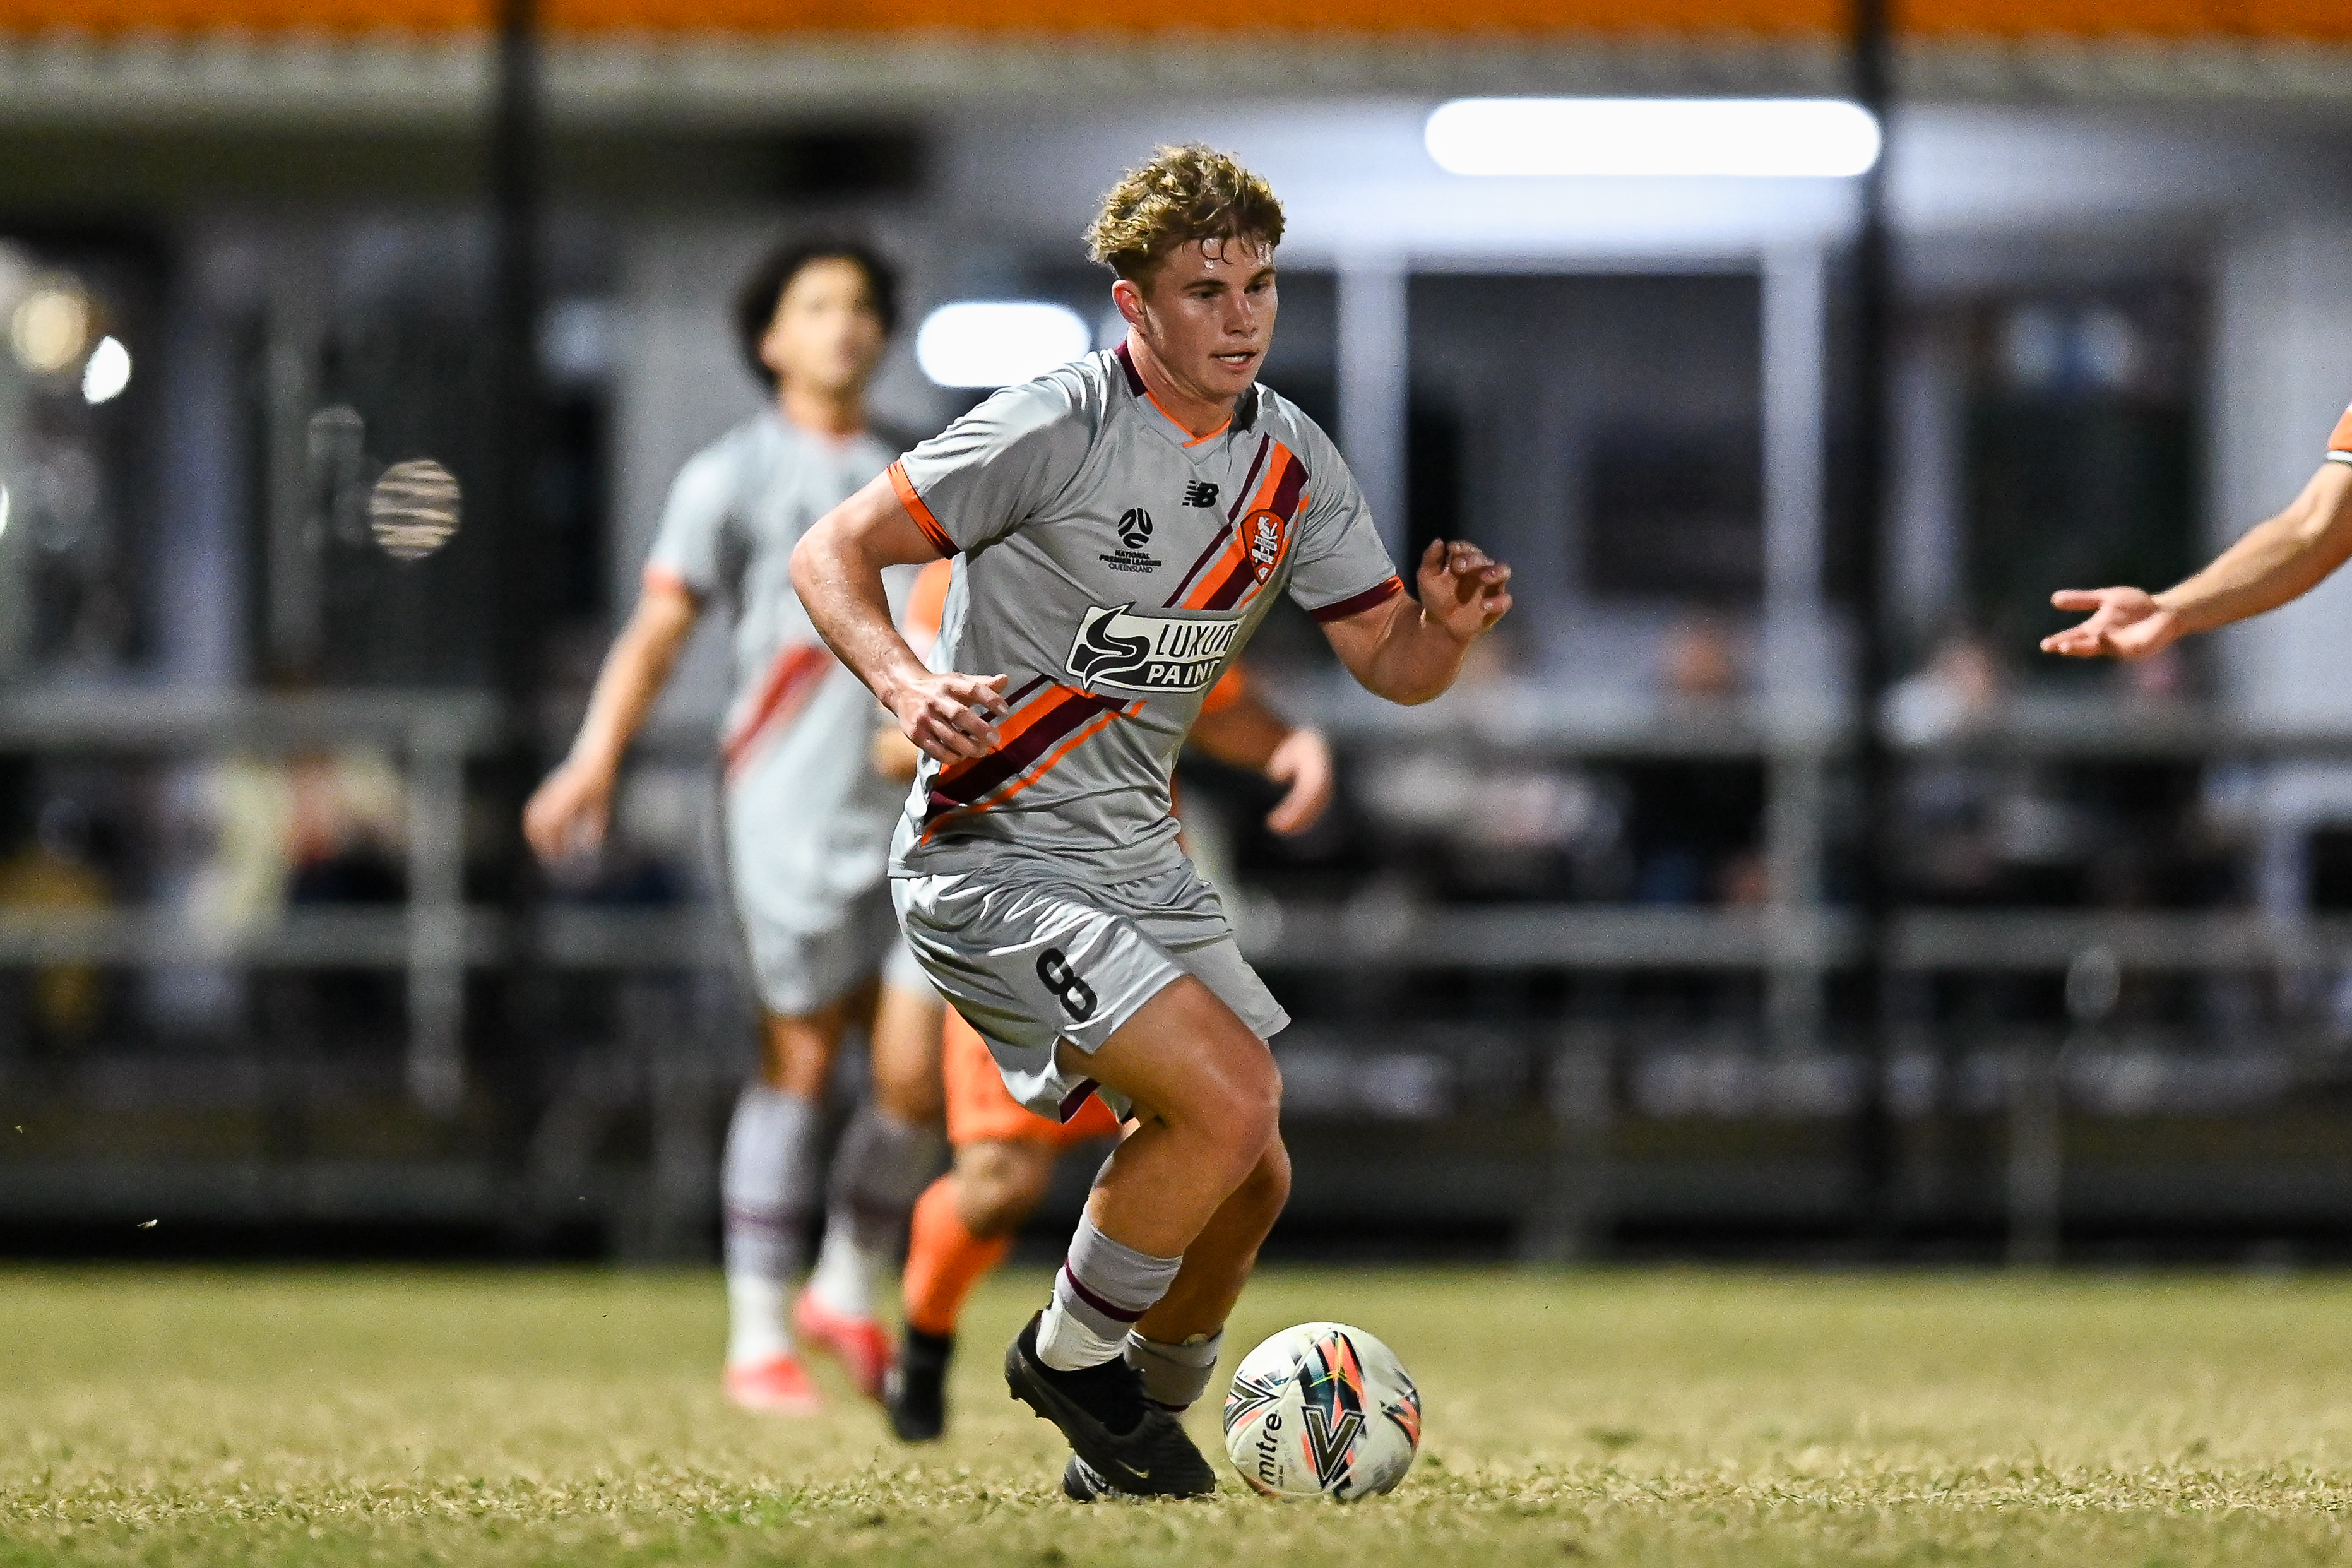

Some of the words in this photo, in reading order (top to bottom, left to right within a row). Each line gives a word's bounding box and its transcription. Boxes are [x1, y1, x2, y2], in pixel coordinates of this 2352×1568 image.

[1099, 554, 1131, 564] PREMIER
[1114, 550, 1150, 559] NATIONAL
[1108, 562, 1153, 573] QUEENSLAND
[1155, 623, 1239, 658] LUXUR
[1036, 947, 1098, 1023] 8
[1256, 1413, 1283, 1485] mitre
